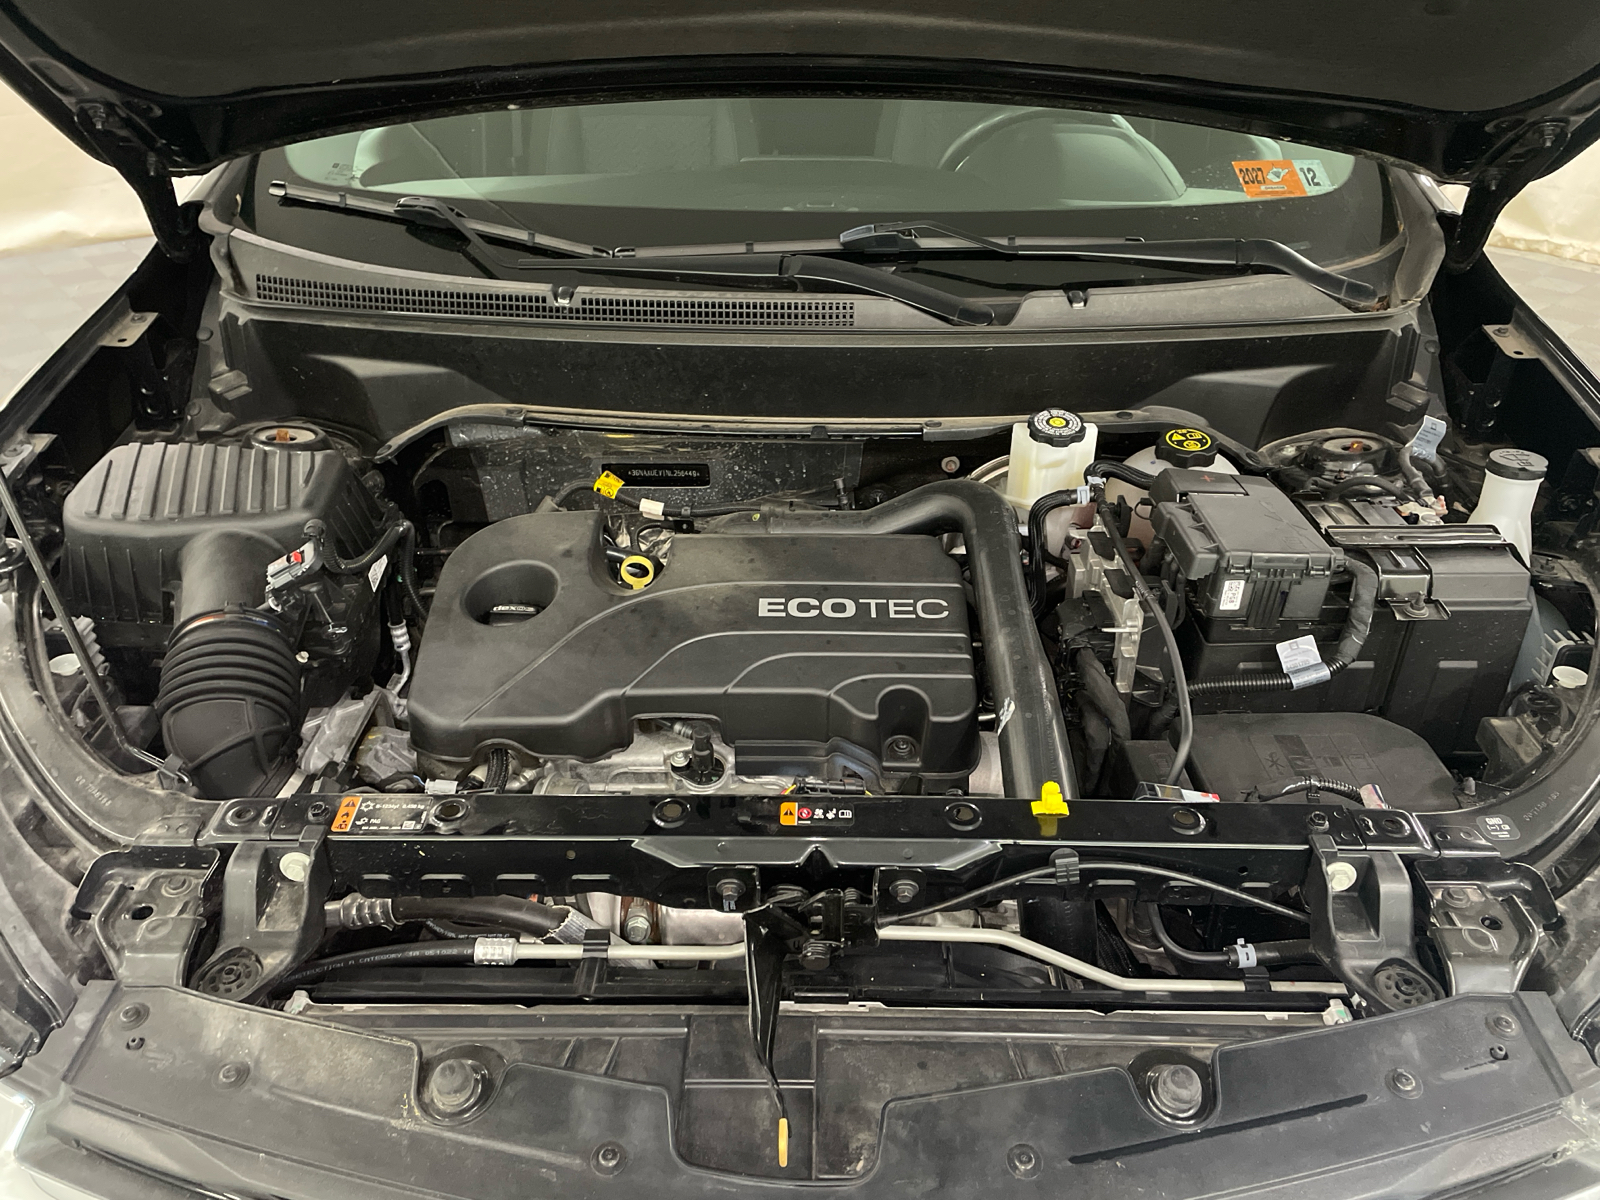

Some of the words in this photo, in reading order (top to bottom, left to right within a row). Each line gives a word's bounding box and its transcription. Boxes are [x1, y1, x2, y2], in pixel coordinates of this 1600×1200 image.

[1239, 167, 1266, 185] 2027
[1299, 167, 1322, 187] 12
[758, 597, 949, 619] ECOTEC
[1485, 817, 1503, 825] GND
